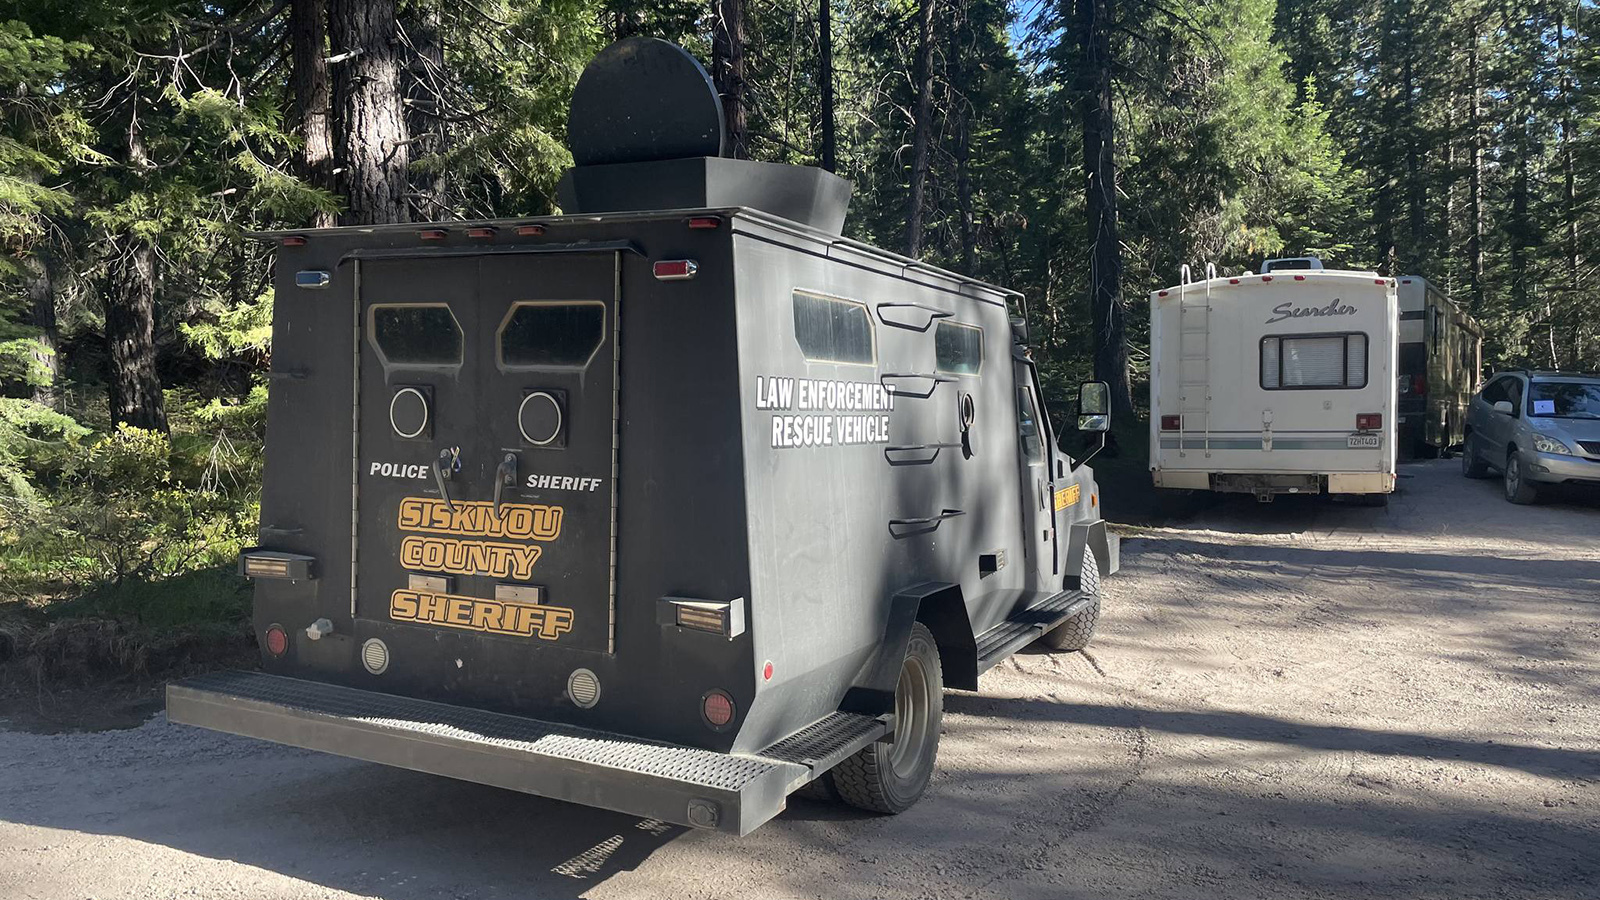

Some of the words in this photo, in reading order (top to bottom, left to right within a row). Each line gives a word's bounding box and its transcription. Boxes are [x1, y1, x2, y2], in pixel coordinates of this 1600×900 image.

[1265, 298, 1357, 324] Searcher
[756, 376, 794, 410] LAW
[798, 378, 896, 411] ENFORCEMENT
[771, 415, 833, 449] RESCUE
[837, 415, 889, 445] VEHICLE
[370, 462, 429, 479] POLICE
[526, 474, 602, 492] SHERIFF
[399, 497, 563, 541] SISKIYOU
[401, 535, 542, 580] COUNTY
[390, 589, 574, 640] SHERIFF
